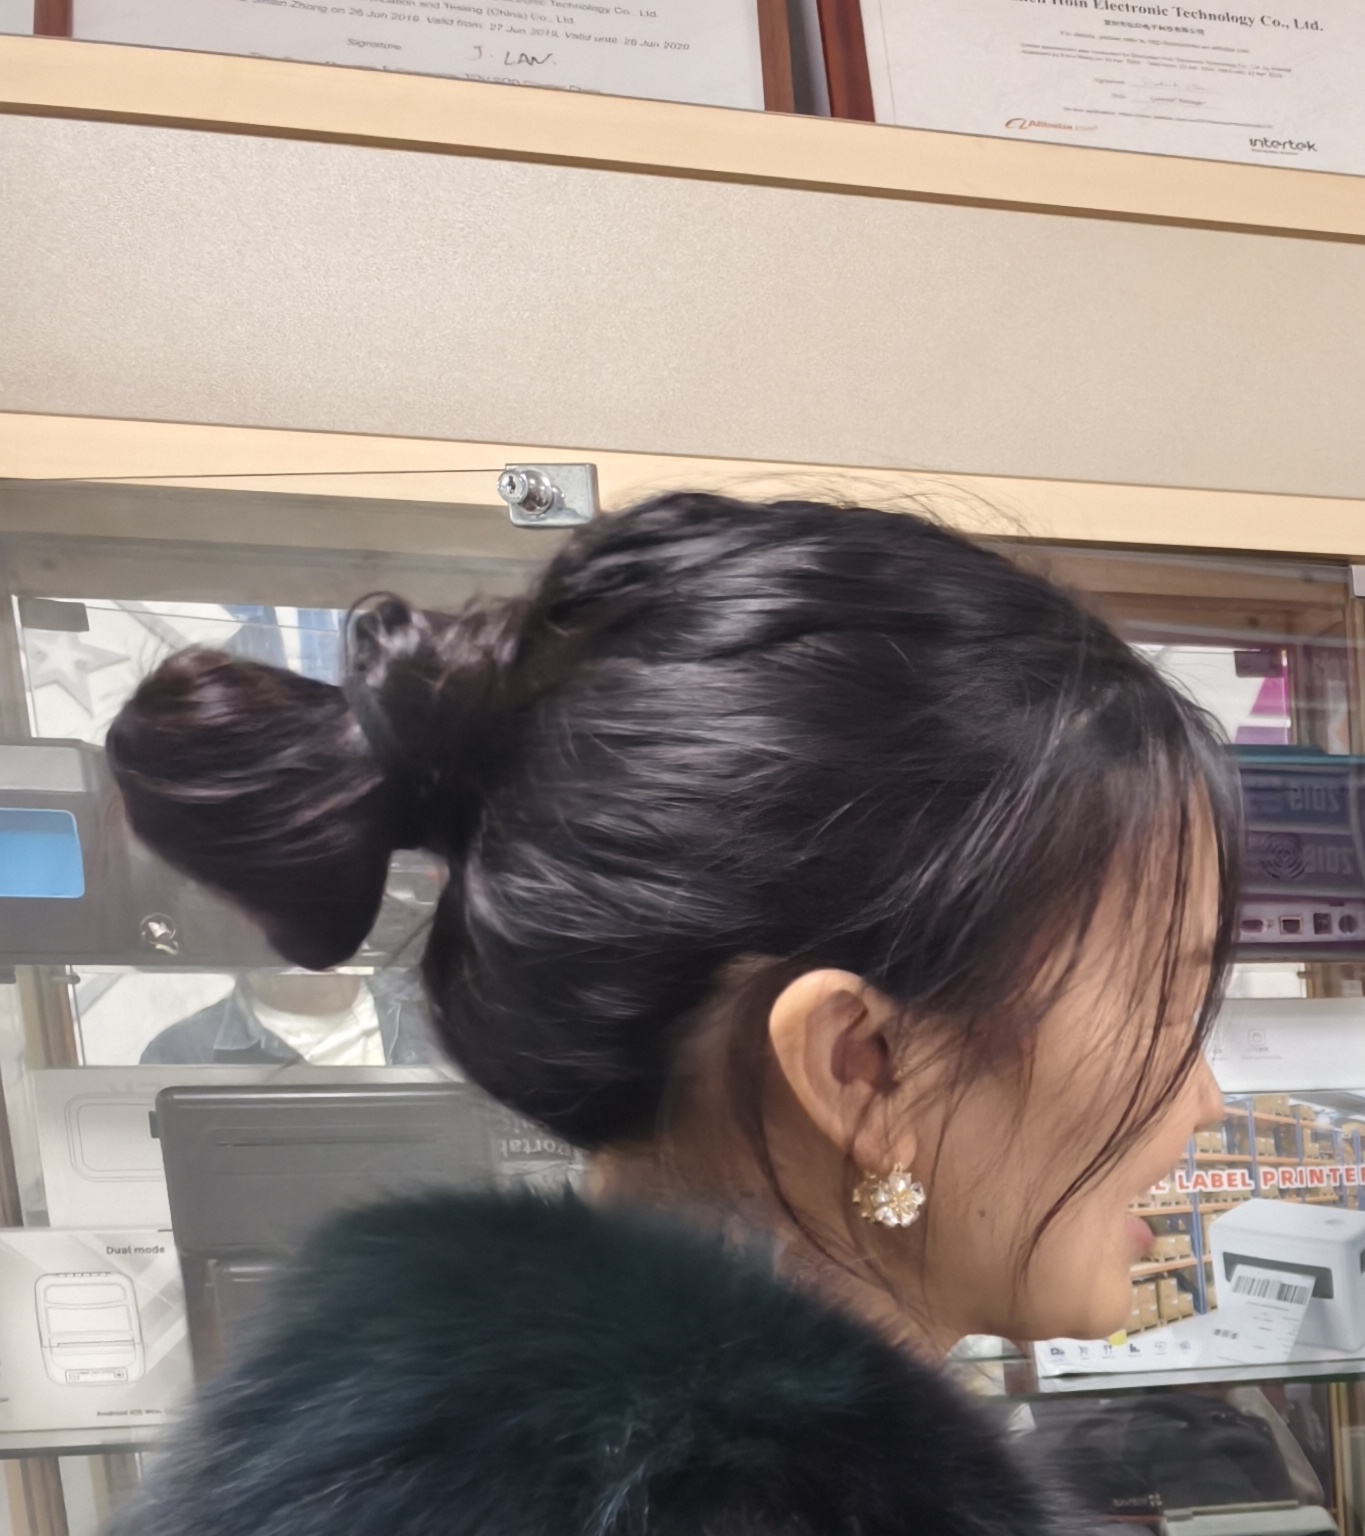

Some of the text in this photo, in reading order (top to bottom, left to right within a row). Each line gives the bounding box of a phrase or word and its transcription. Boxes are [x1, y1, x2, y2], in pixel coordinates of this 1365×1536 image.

[1172, 6, 1256, 27] Technology
[1293, 18, 1324, 32] Ltd.
[1176, 1170, 1253, 1192] LABEL
[106, 1244, 166, 1255] Dual mode
